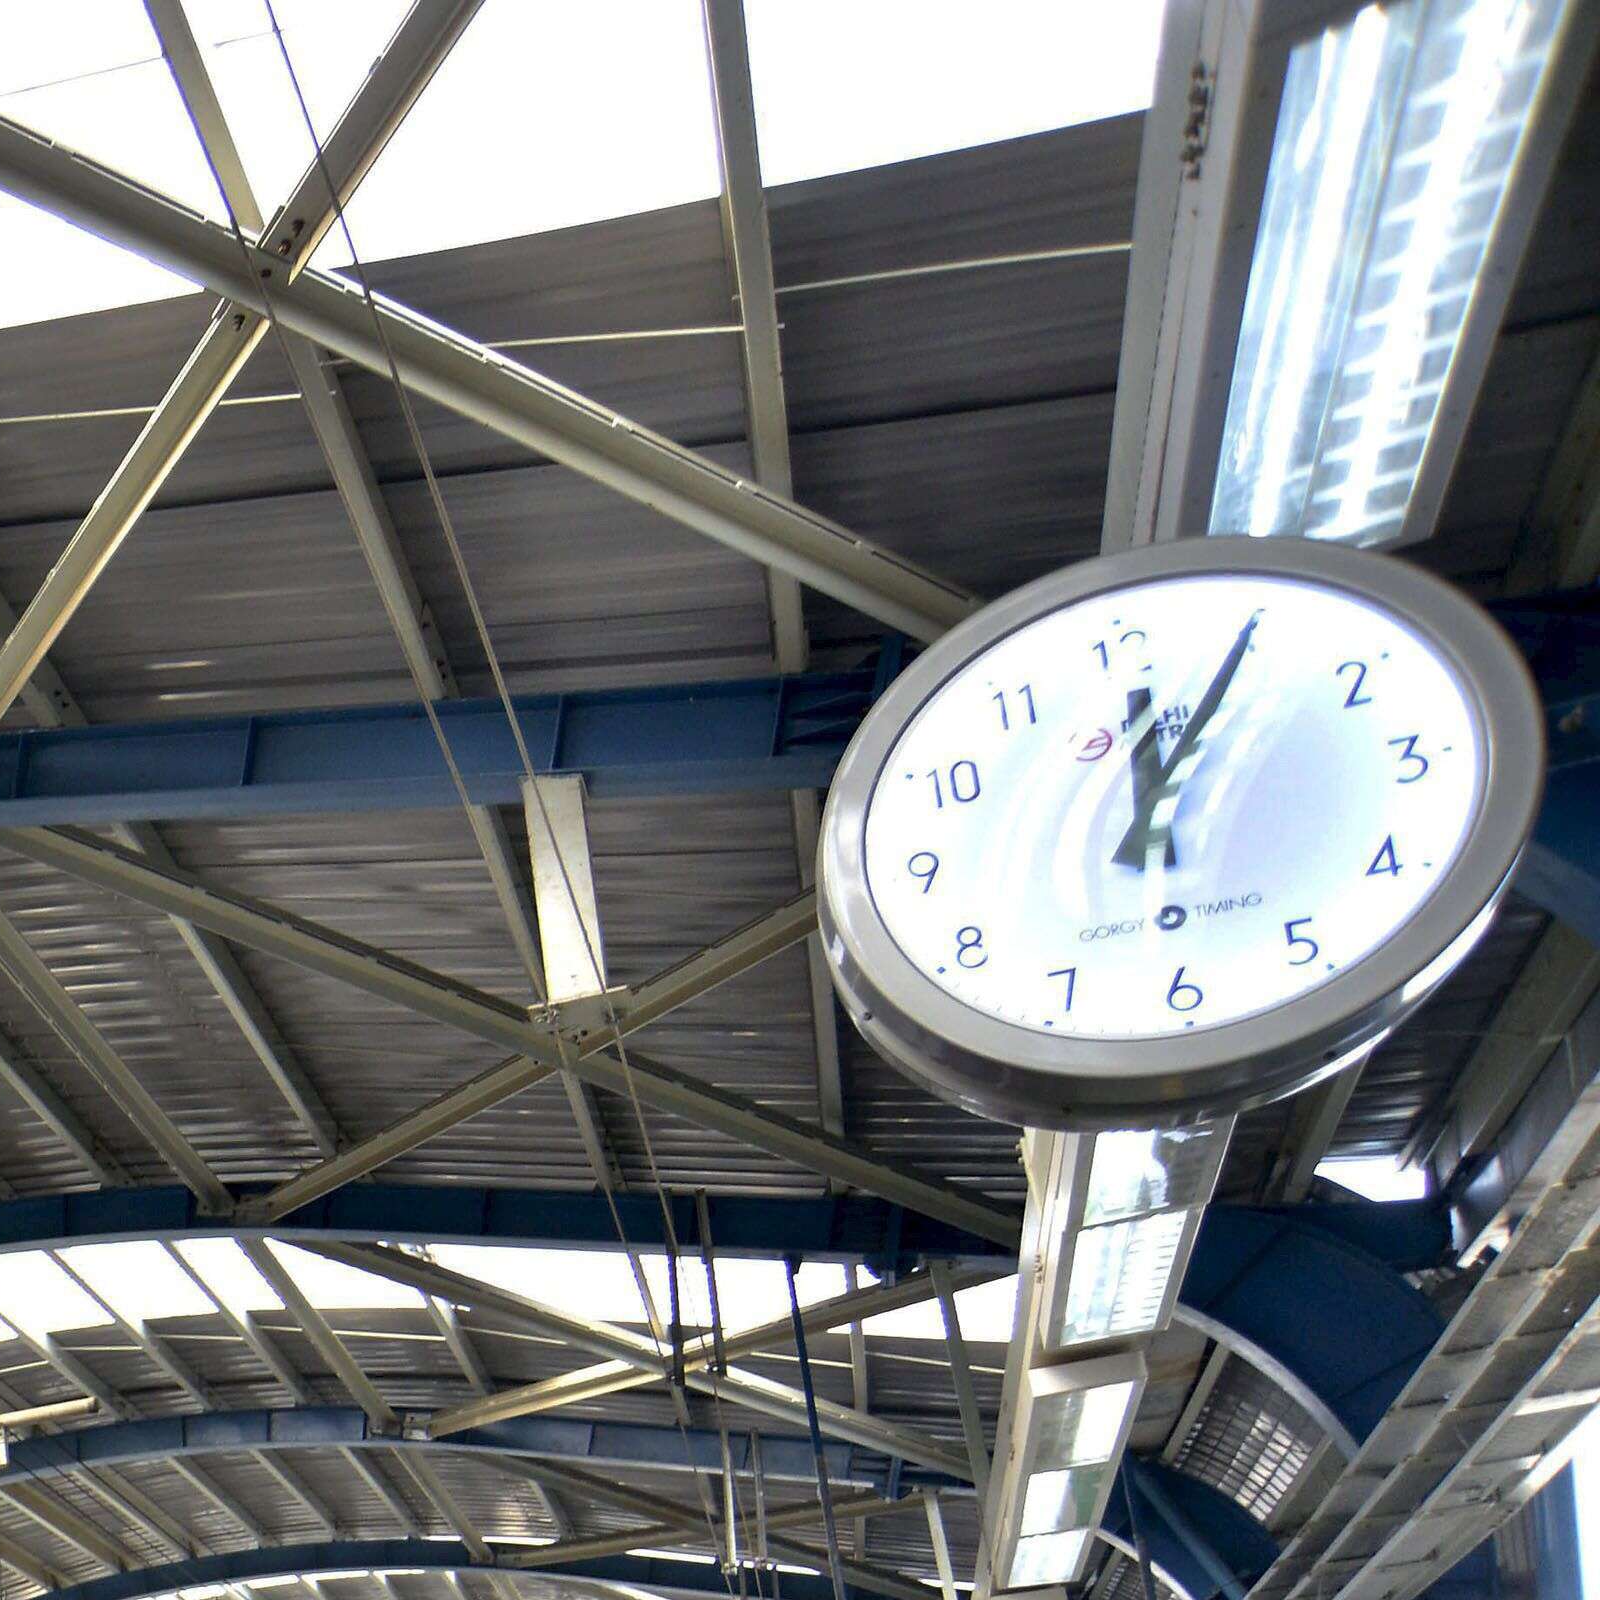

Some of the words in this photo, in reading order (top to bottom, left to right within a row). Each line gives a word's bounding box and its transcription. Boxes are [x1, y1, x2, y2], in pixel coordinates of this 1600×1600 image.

[992, 684, 1039, 731] 11
[1335, 661, 1373, 709] 2
[1389, 734, 1429, 784] 3
[926, 759, 983, 809] 10
[907, 850, 941, 895] 9
[1366, 834, 1404, 879] 4
[1079, 918, 1145, 942] GORGY
[1195, 892, 1263, 917] TIMING
[954, 925, 989, 968] 8
[1284, 917, 1320, 966] 5
[1046, 967, 1080, 1012] 7
[1167, 966, 1203, 1011] 6
